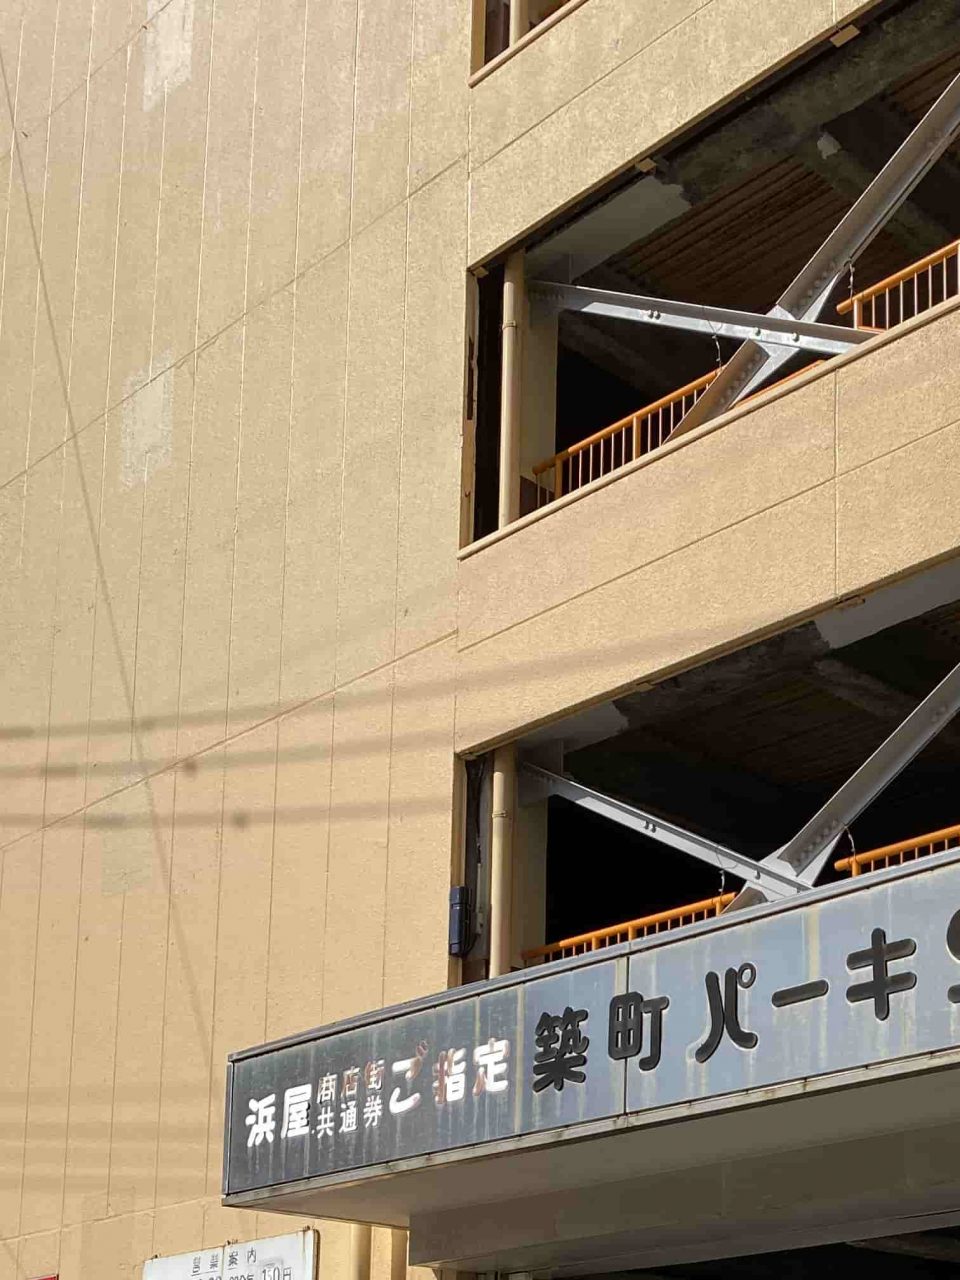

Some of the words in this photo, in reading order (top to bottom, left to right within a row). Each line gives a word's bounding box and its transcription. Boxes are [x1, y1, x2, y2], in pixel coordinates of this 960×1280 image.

[316, 1059, 385, 1104] 商店街
[389, 1038, 510, 1114] ご指定
[245, 1083, 312, 1148] 浜屋
[316, 1096, 383, 1139] 共通券
